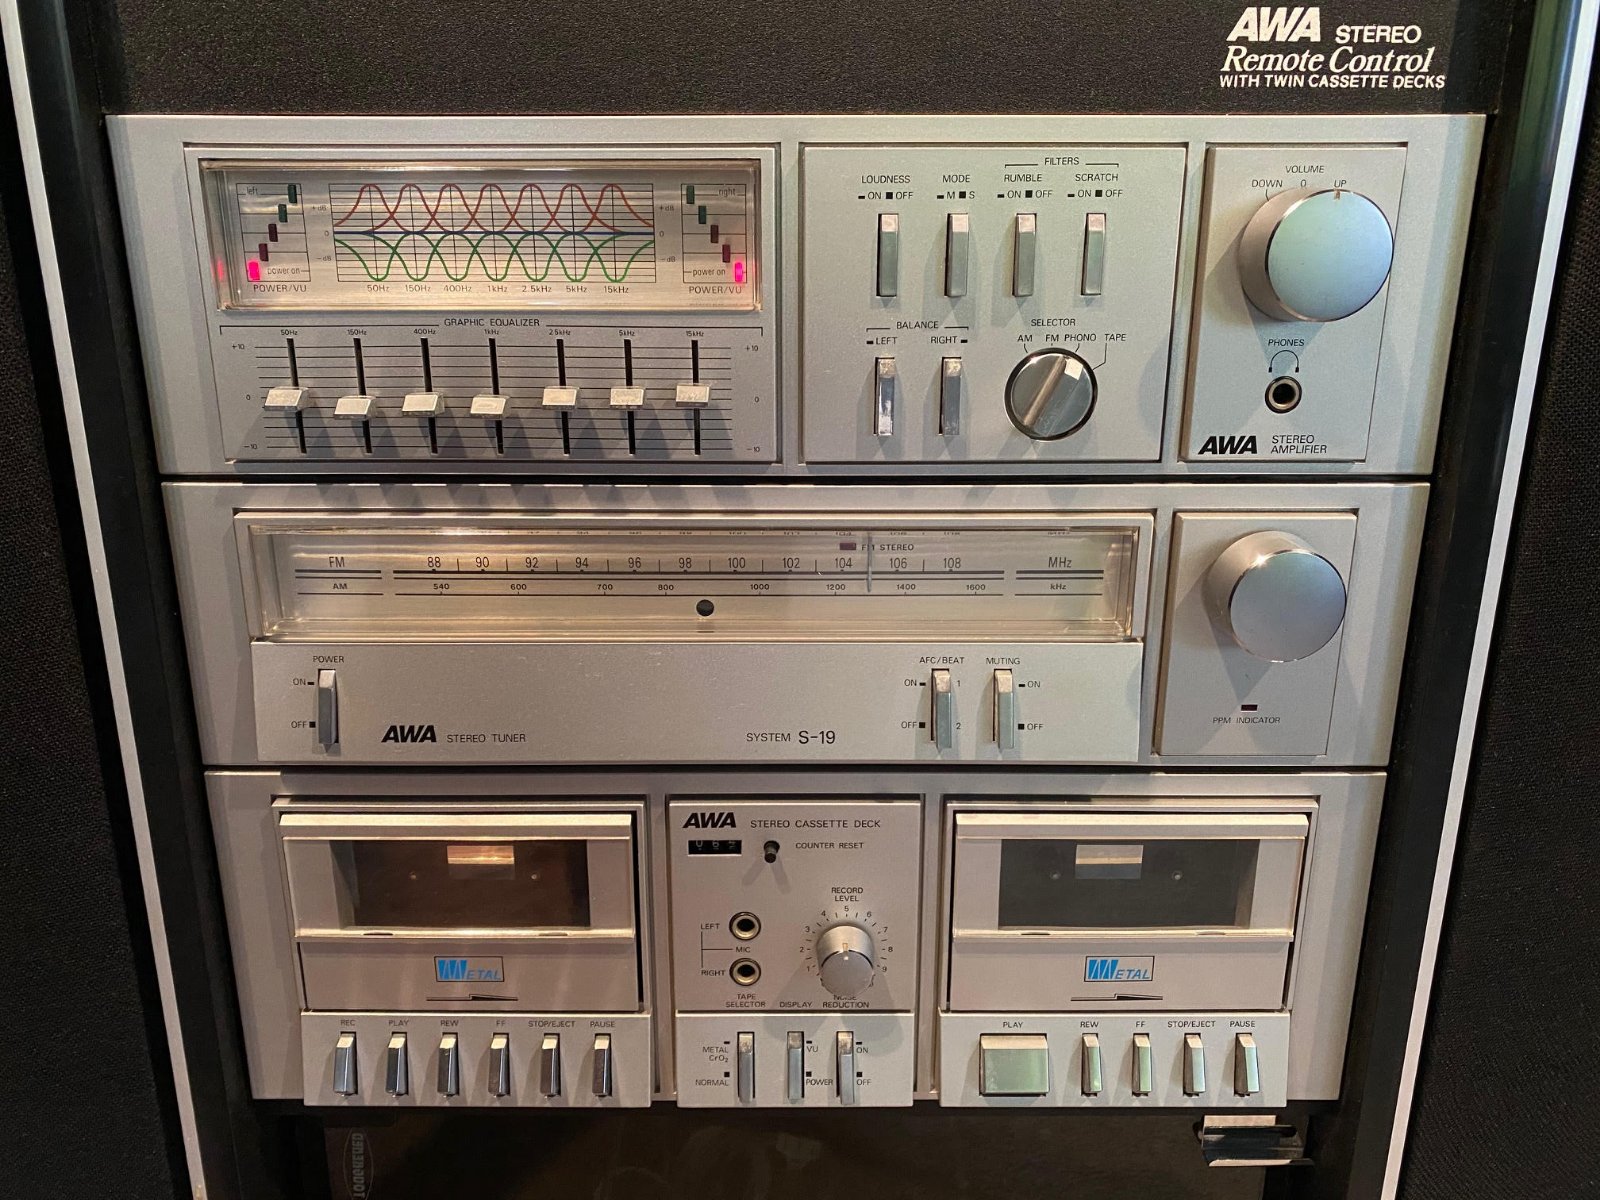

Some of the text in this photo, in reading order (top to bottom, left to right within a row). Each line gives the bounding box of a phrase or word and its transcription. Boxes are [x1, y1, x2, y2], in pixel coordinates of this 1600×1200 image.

[1226, 6, 1422, 44] AWA STEREO
[1220, 45, 1436, 73] Remote Control
[1219, 74, 1446, 89] WITH TWIN CASSETTE DECKS
[1044, 156, 1080, 166] FILTERS
[1285, 165, 1325, 174] VOLUME
[861, 174, 911, 184] LOUDNESS
[942, 174, 971, 183] MODE
[1003, 173, 1042, 183] RUMBLE
[1075, 172, 1119, 182] SCRATCH
[1251, 179, 1283, 188] DOWN
[1333, 179, 1347, 188] UP
[718, 187, 736, 197] right
[867, 191, 914, 200] ON OFF
[946, 191, 976, 200] M S
[1007, 190, 1053, 199] ON OFF
[1077, 189, 1123, 198] ON OFF
[267, 267, 300, 276] power on
[692, 267, 726, 277] power on
[253, 283, 307, 293] POWER/VU
[367, 284, 389, 292] 50Hz
[405, 284, 431, 292] 150Hz
[444, 284, 472, 292] 400Hz
[487, 284, 508, 293] 1kHz
[521, 285, 552, 293] 2.5kHz
[566, 285, 587, 293] 5kHz
[603, 285, 629, 294] 15kHz
[688, 286, 742, 295] POWER/VU
[444, 318, 540, 327] GRAPHIC EQUALIZER
[896, 321, 939, 330] BALANCE
[1030, 318, 1076, 327] SELECTOR
[413, 328, 436, 336] 400Hz
[484, 328, 499, 336] 1kHz
[618, 329, 635, 337] 5kHz
[875, 336, 898, 345] LEFT
[930, 336, 958, 345] RIGHT
[1017, 334, 1033, 343] AM
[1045, 334, 1060, 343] FM
[1064, 333, 1097, 342] PHONO
[1104, 333, 1127, 342] TAPE
[1268, 338, 1305, 347] PHONES
[745, 344, 759, 352] +10
[1198, 434, 1315, 455] AWA STEREO
[1271, 444, 1328, 454] AMPLIFIER
[879, 543, 915, 551] STEREO
[328, 556, 1072, 569] FM 88 90 92 94 96 98 100 102 104 106 108 MHz
[510, 583, 527, 591] 600
[597, 583, 613, 591] 700
[750, 583, 770, 591] 1000
[826, 583, 846, 591] 1200
[896, 583, 916, 591] 1400
[965, 583, 986, 591] 1600
[1050, 583, 1067, 591] kHz
[313, 656, 345, 664] POWER
[919, 656, 964, 665] AFC/BEAT
[985, 657, 1021, 665] MUTING
[293, 678, 306, 686] ON
[904, 679, 917, 687] ON
[1027, 680, 1041, 688] ON
[1212, 716, 1281, 724] PPM INDICATOR
[291, 721, 307, 729] OFF
[901, 721, 918, 729] OFF
[956, 722, 961, 730] 2
[1027, 723, 1043, 731] OFF
[381, 725, 526, 743] AWA STEREO TUNER
[746, 730, 836, 745] SYSTEM S-19
[682, 812, 881, 829] AWA STEREO CASSETTE DECK
[795, 842, 835, 850] COUNTER
[883, 926, 888, 934] 7
[437, 960, 501, 980] METAL
[701, 969, 726, 977] RIGHT
[1088, 959, 1151, 980] METAL
[340, 1019, 356, 1027] REC
[388, 1019, 409, 1027] PLAY
[528, 1020, 575, 1028] STOP/EJECT
[589, 1020, 615, 1028] PAUSE
[1135, 1020, 1146, 1028] FF
[1167, 1020, 1216, 1028] STOP/EJECT
[1229, 1020, 1256, 1028] PAUSE
[856, 1046, 869, 1054] ON
[806, 1078, 833, 1086] POWER
[856, 1078, 871, 1086] OFF
